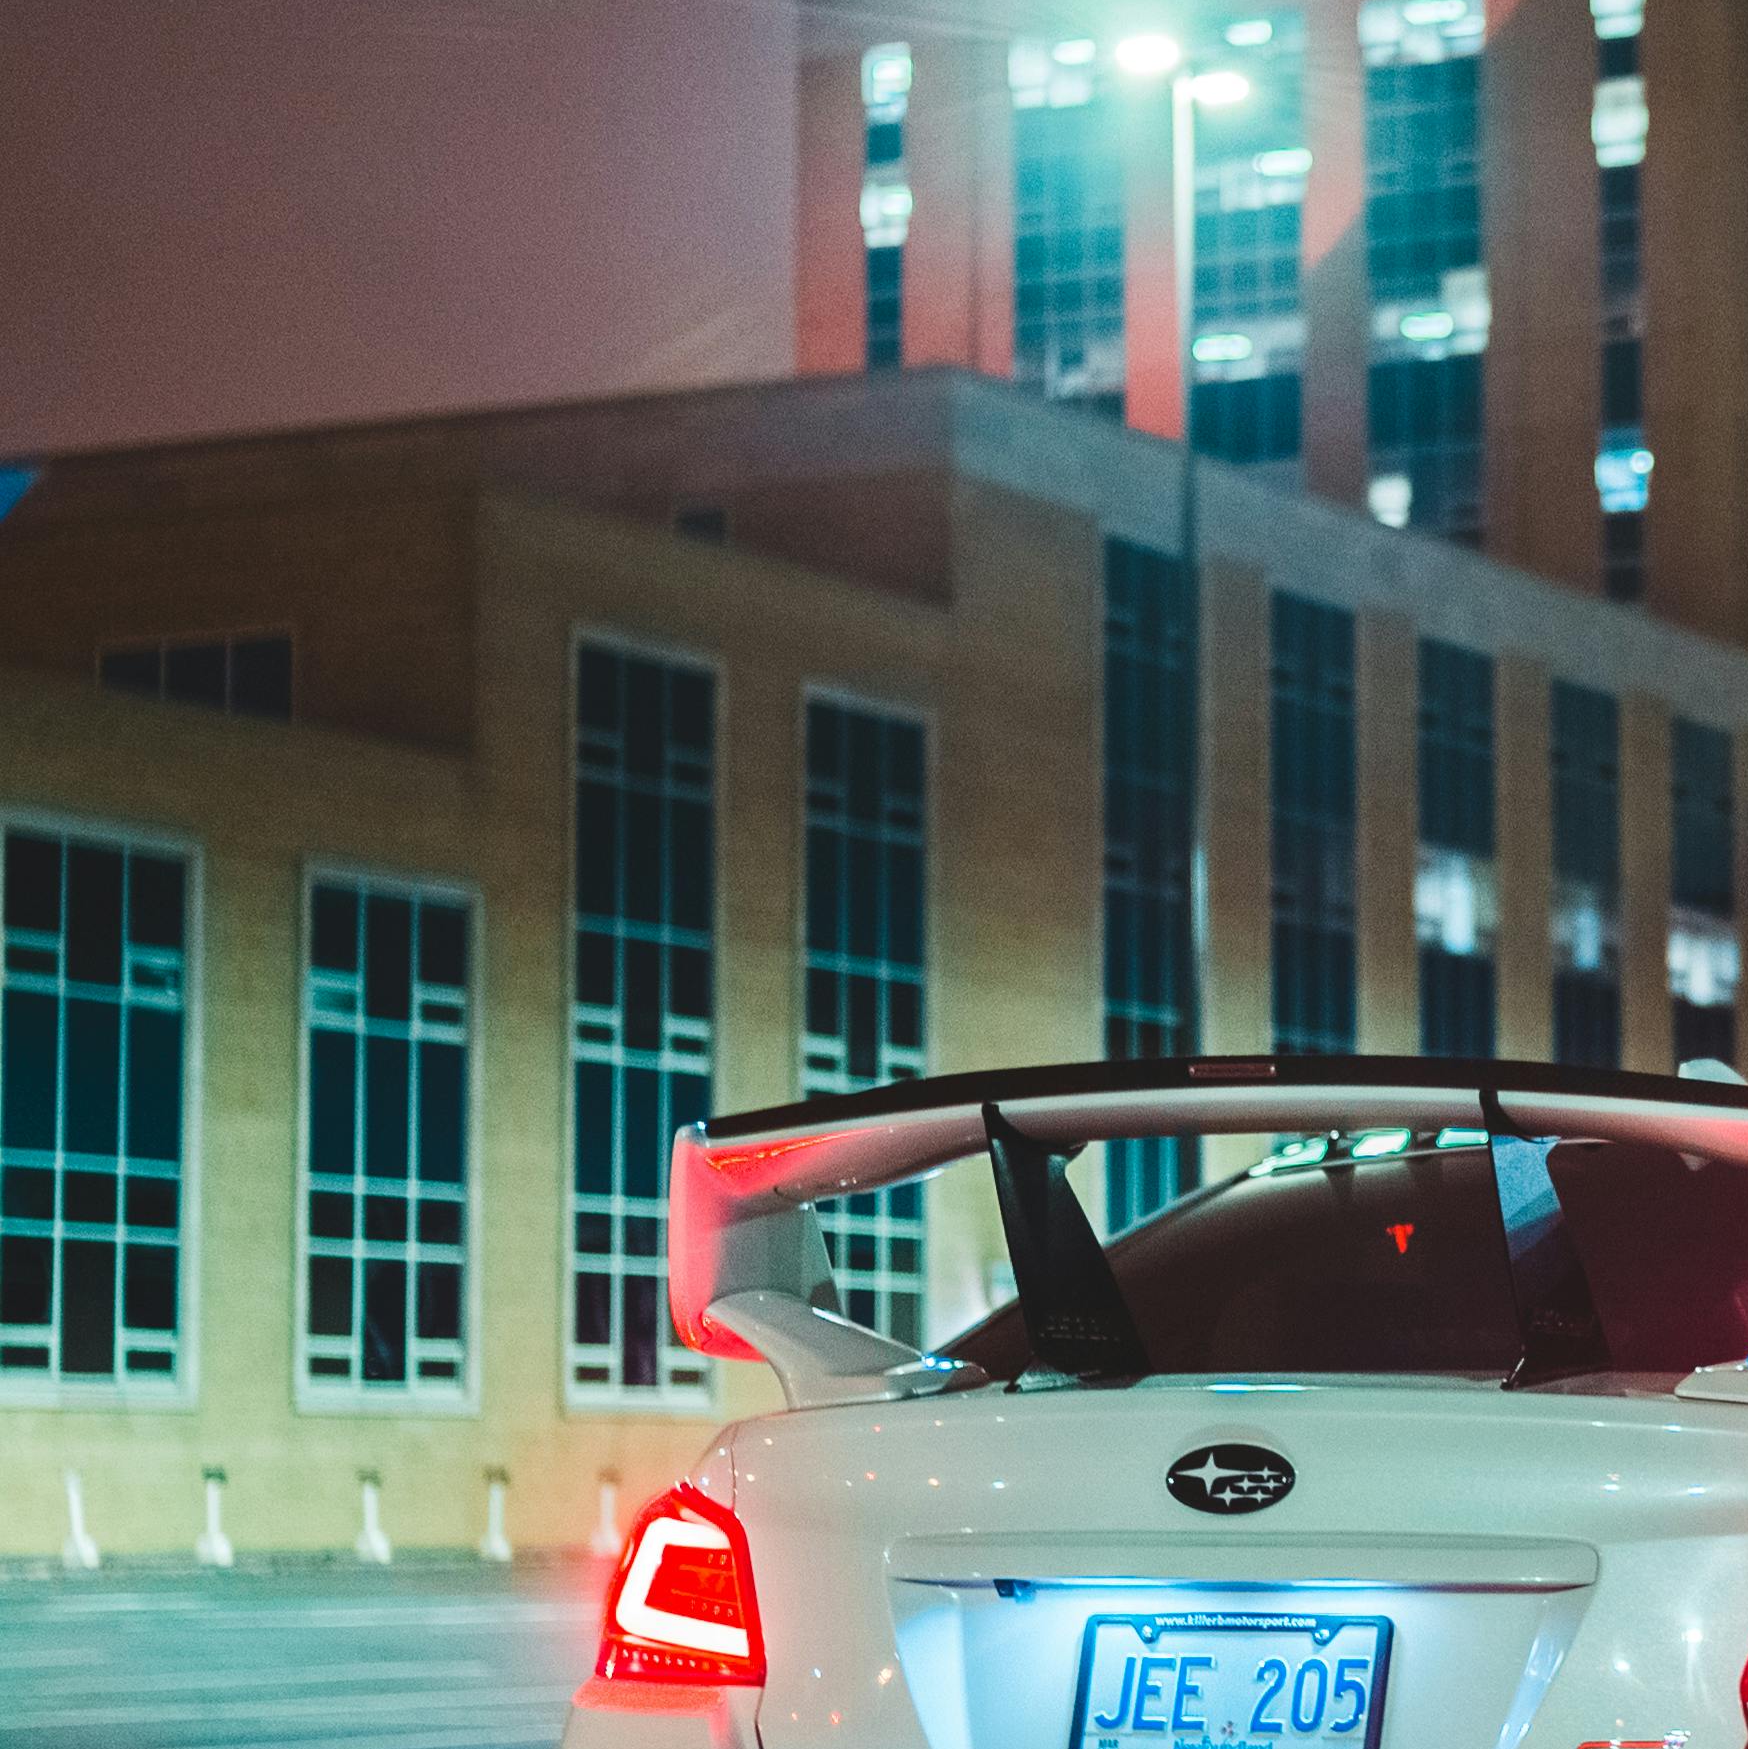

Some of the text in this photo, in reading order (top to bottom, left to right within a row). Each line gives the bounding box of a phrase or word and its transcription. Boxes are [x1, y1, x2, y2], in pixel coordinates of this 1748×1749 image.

[1154, 1613, 1317, 1630] www.killerbmotorsport.com
[1093, 1655, 1371, 1734] JEE 205
